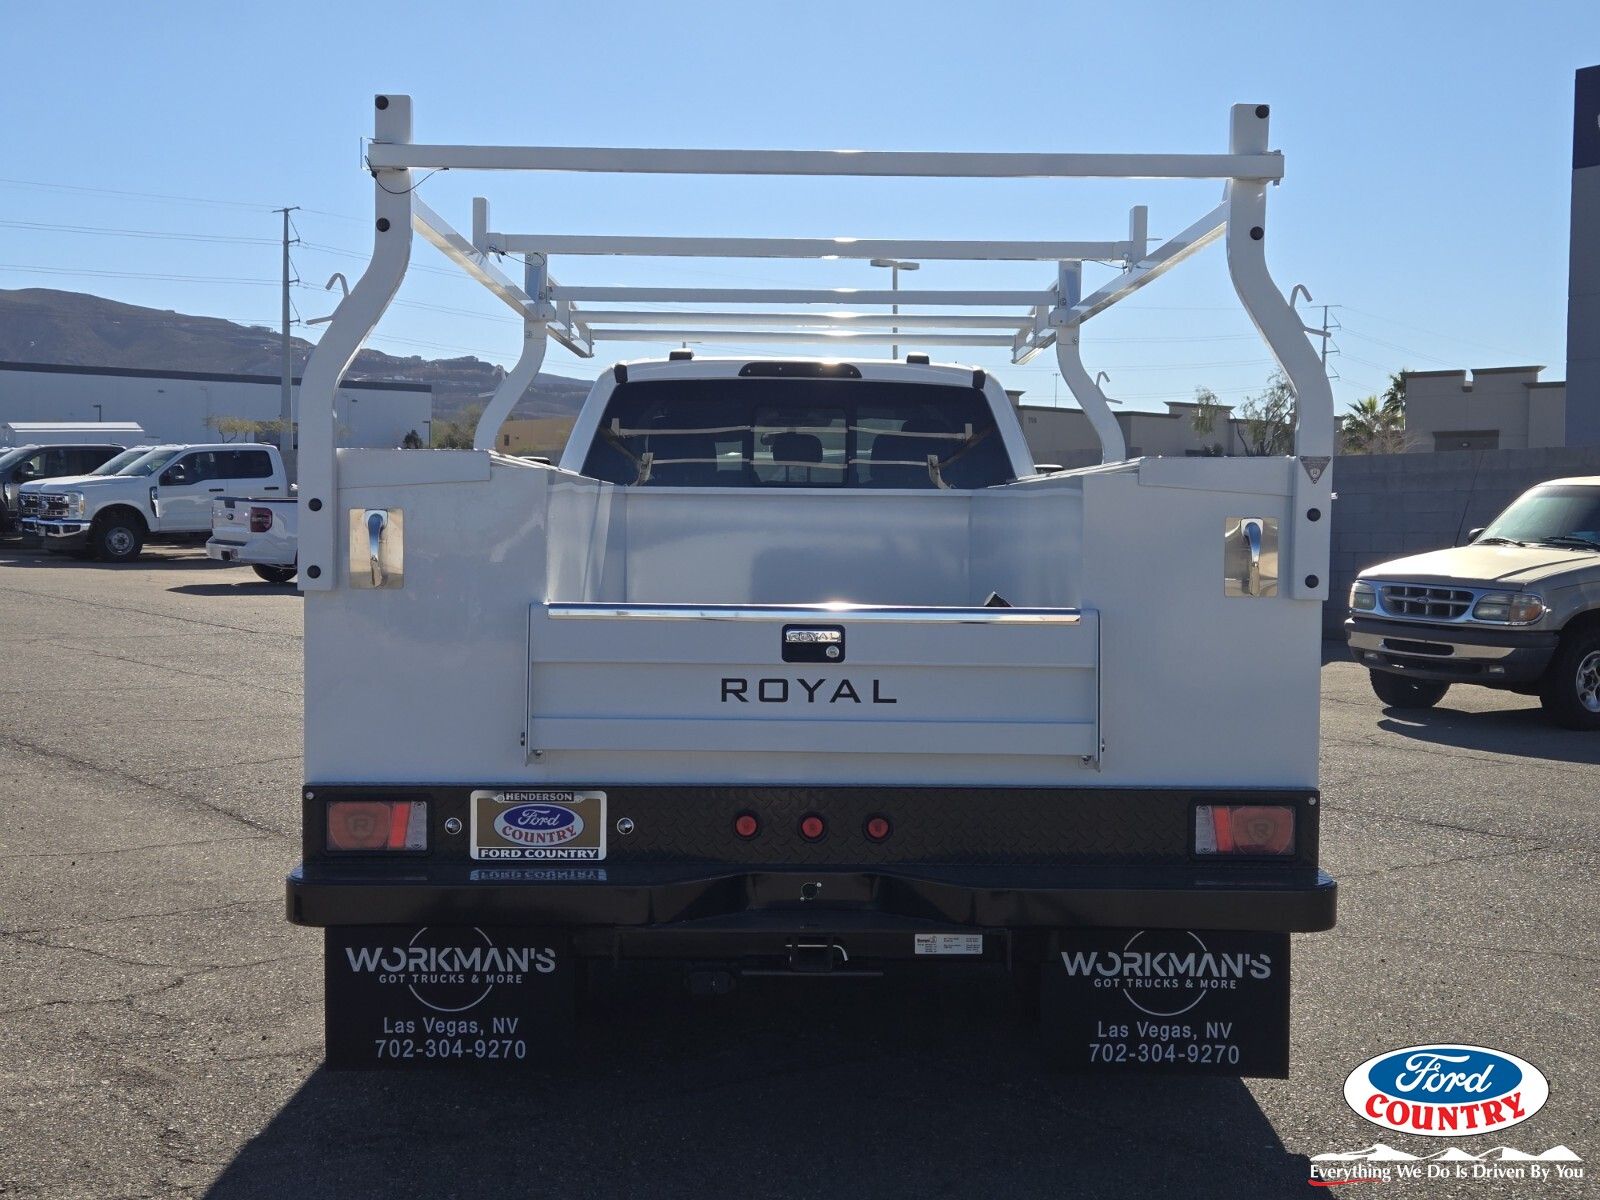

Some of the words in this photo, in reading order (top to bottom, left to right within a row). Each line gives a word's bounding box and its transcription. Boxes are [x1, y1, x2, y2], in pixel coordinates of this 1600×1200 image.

[721, 678, 897, 704] ROYAL
[505, 793, 573, 801] HENDERSON
[518, 809, 560, 826] Ford
[502, 825, 577, 844] COUNTRY
[480, 849, 522, 859] FORD
[525, 849, 598, 859] COUNTRY
[345, 947, 556, 973] WORKMAN'S
[1061, 951, 1272, 979] WORKMAN'S
[379, 974, 405, 984] GOT
[412, 974, 466, 984] TRUCKS
[471, 974, 480, 984] &
[486, 974, 523, 984] MORE
[1094, 979, 1120, 988] GOT
[1127, 979, 1179, 989] TRUCKS
[1185, 979, 1194, 989] &
[1200, 979, 1237, 990] MORE
[383, 1017, 415, 1034] Las
[422, 1017, 485, 1037] Vegas,
[493, 1017, 519, 1034] NV
[1098, 1021, 1129, 1038] Las
[1136, 1021, 1198, 1041] Vegas,
[1206, 1022, 1233, 1039] NV
[375, 1039, 527, 1059] 702-304-9270
[1089, 1043, 1240, 1064] 702-304-9270
